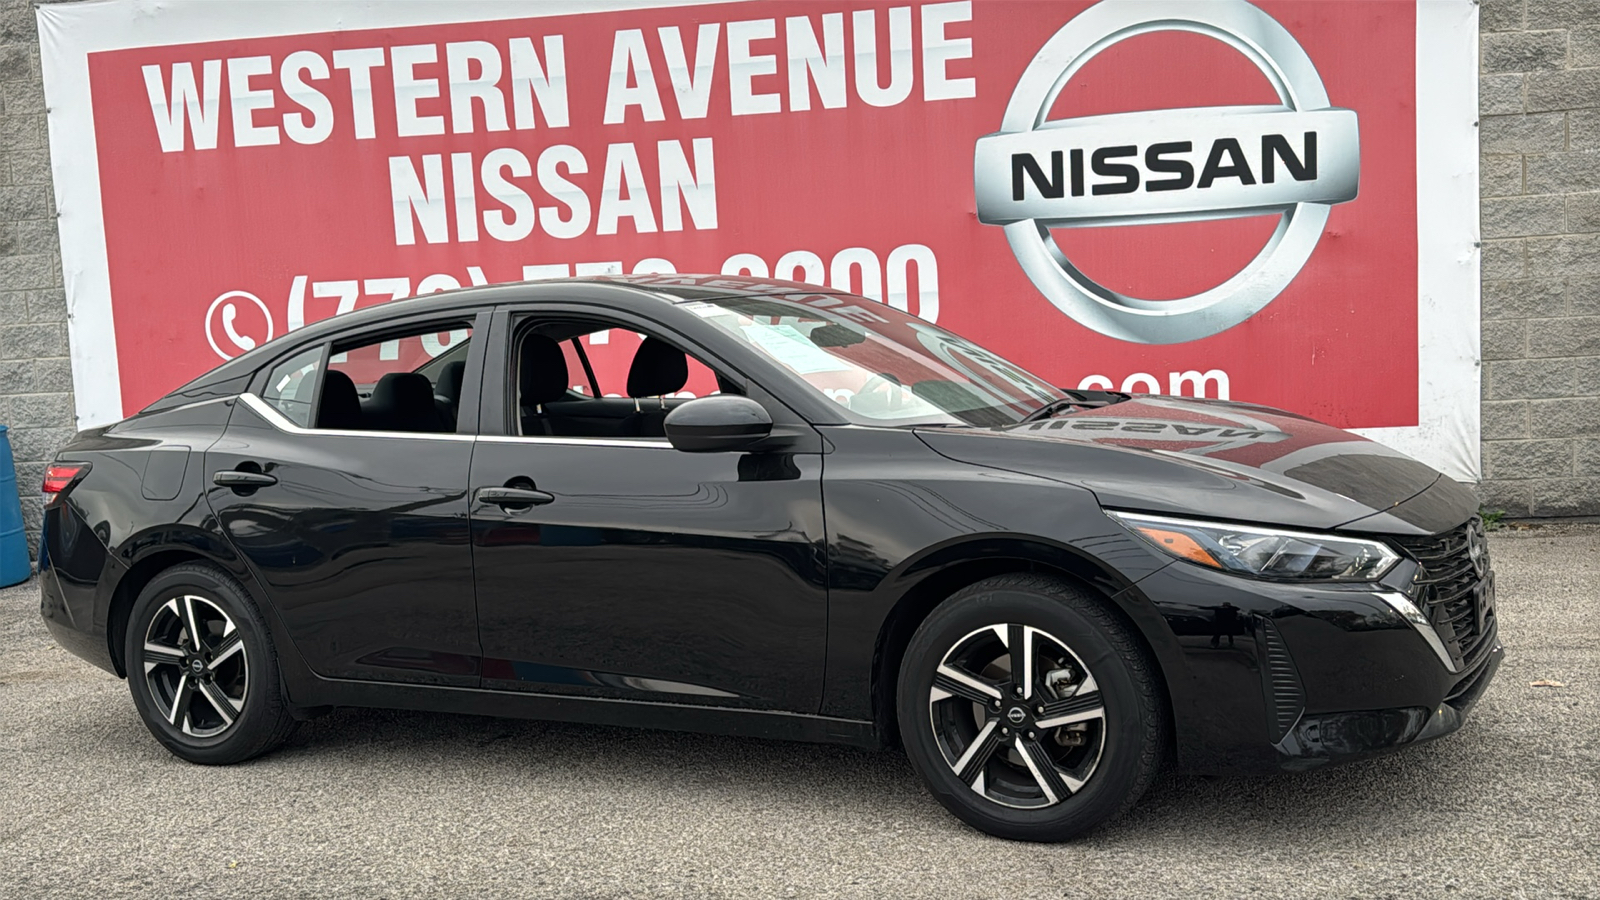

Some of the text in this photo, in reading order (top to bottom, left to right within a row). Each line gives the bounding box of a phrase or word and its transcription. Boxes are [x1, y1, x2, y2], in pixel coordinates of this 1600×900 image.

[142, 0, 977, 153] WESTERN AVENUE
[389, 137, 718, 246] NISSAN
[1012, 131, 1318, 202] NISSAN
